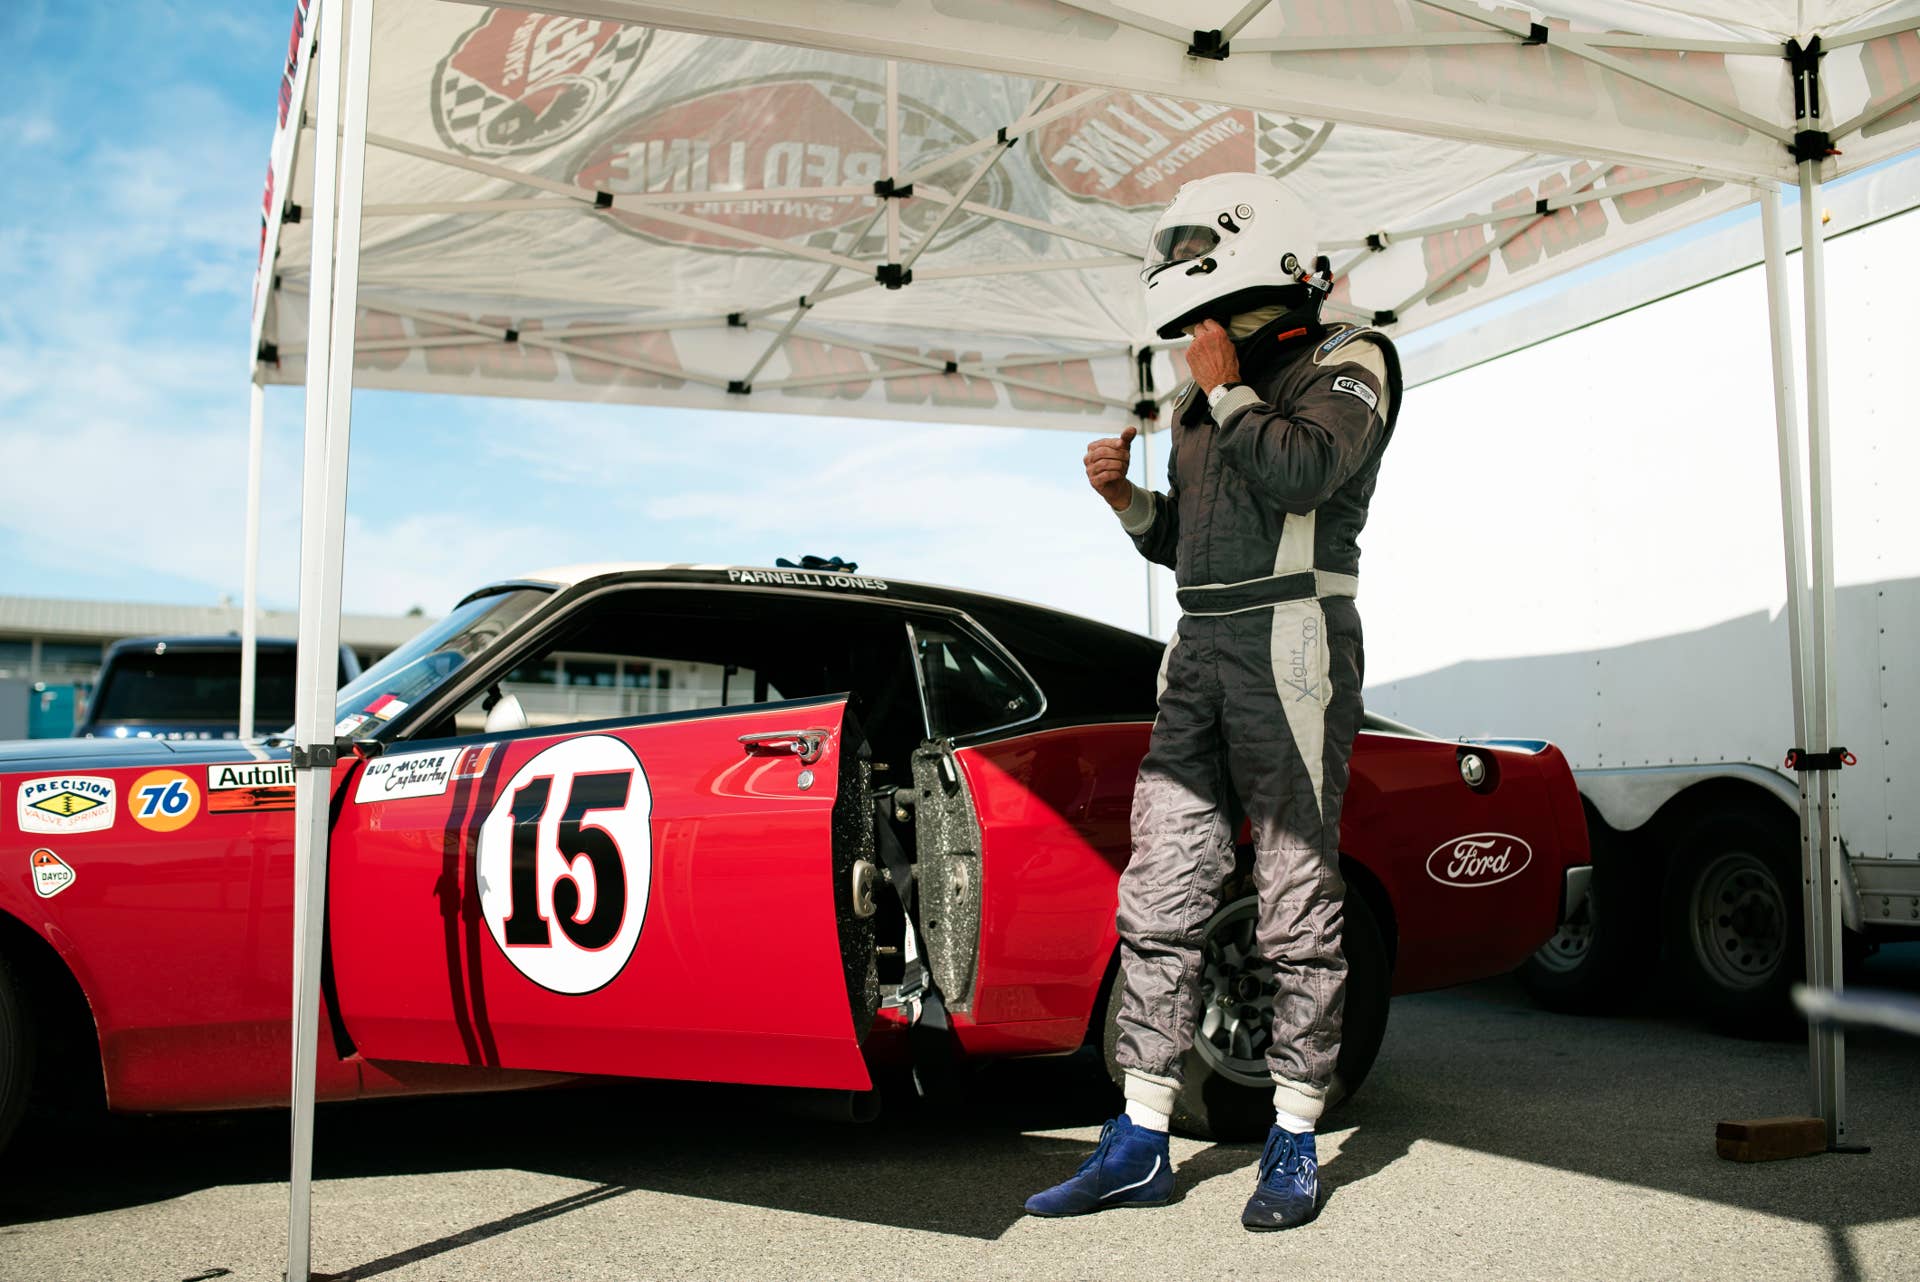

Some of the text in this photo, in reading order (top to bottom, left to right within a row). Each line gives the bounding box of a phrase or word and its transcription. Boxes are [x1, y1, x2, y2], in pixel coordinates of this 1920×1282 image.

[727, 569, 888, 591] PARNELLI JONES
[219, 766, 296, 787] Autolit
[366, 757, 445, 776] BUD MOORE
[24, 780, 111, 798] PRECISION
[385, 766, 447, 791] Engineering
[139, 779, 191, 818] 76
[24, 806, 109, 827] VALVE SPRINGS
[503, 768, 635, 952] 15
[1447, 840, 1511, 878] Ford
[42, 872, 68, 881] DAYCO
